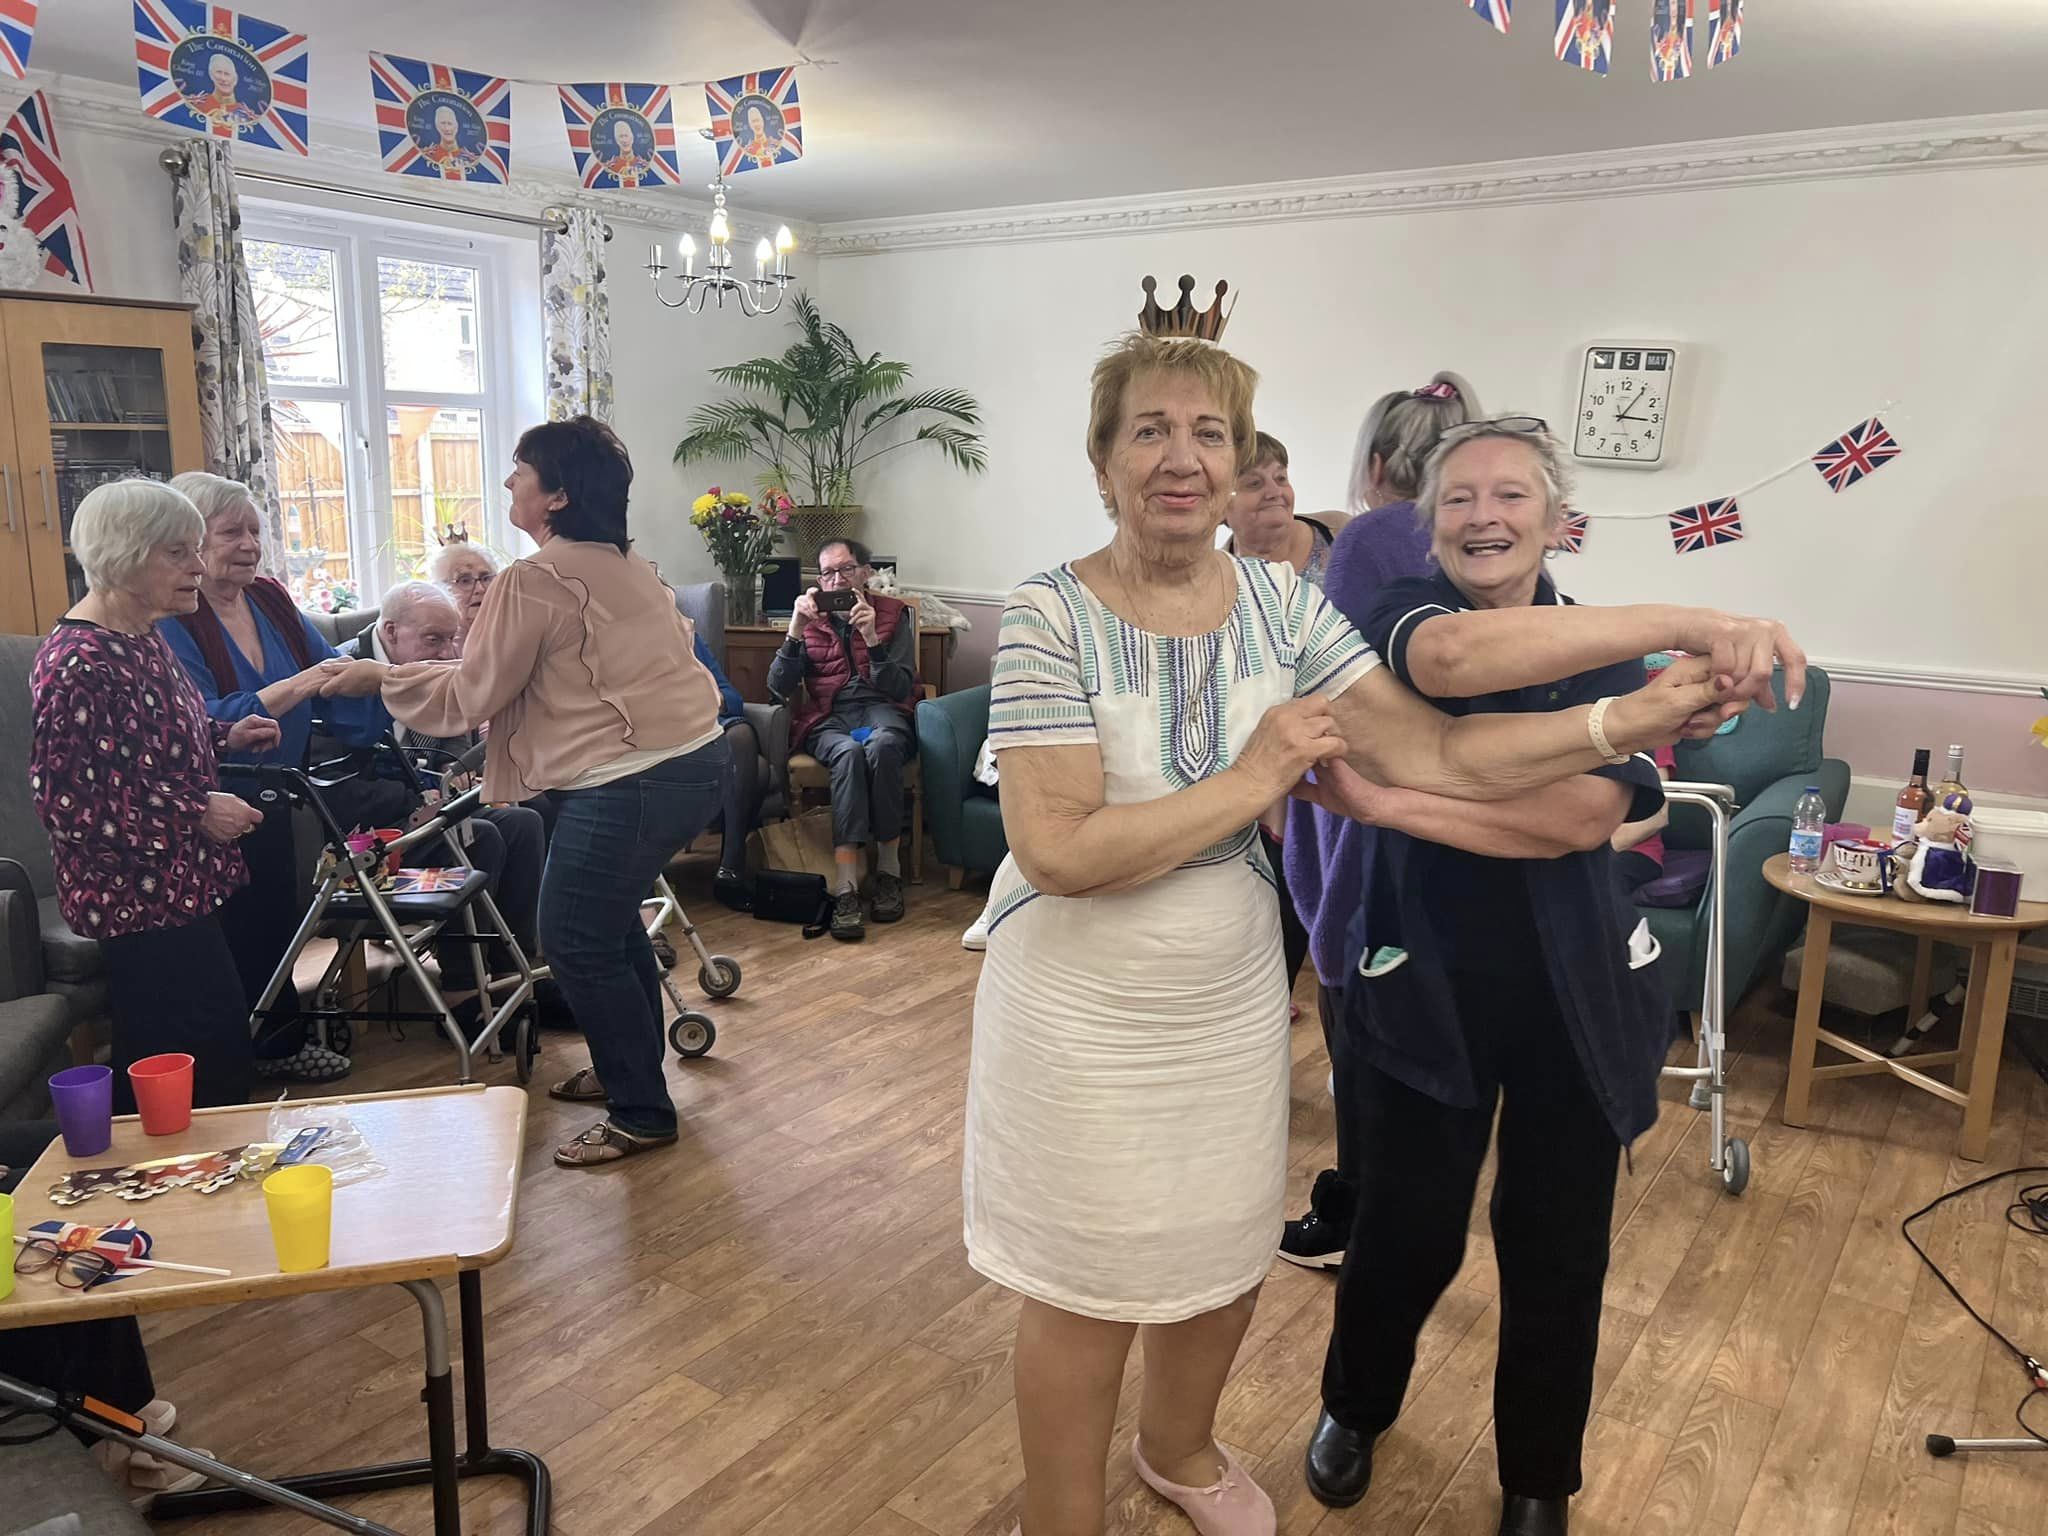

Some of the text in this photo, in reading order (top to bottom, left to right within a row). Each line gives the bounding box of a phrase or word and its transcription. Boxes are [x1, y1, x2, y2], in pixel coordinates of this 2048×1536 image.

[187, 39, 257, 72] The Coronation
[417, 95, 473, 118] The Coronation
[1625, 354, 1636, 367] 5
[1648, 355, 1667, 366] MAY
[1606, 385, 1614, 394] 11
[1621, 381, 1632, 391] 12
[1593, 396, 1604, 405] 10
[1649, 398, 1656, 408] 2
[1586, 410, 1593, 420] 9
[1651, 414, 1659, 424] 3
[1588, 427, 1596, 436] 8
[1644, 430, 1652, 439] 4
[1600, 438, 1606, 448] 7
[1614, 443, 1621, 453] 6
[1630, 440, 1638, 449] 5
